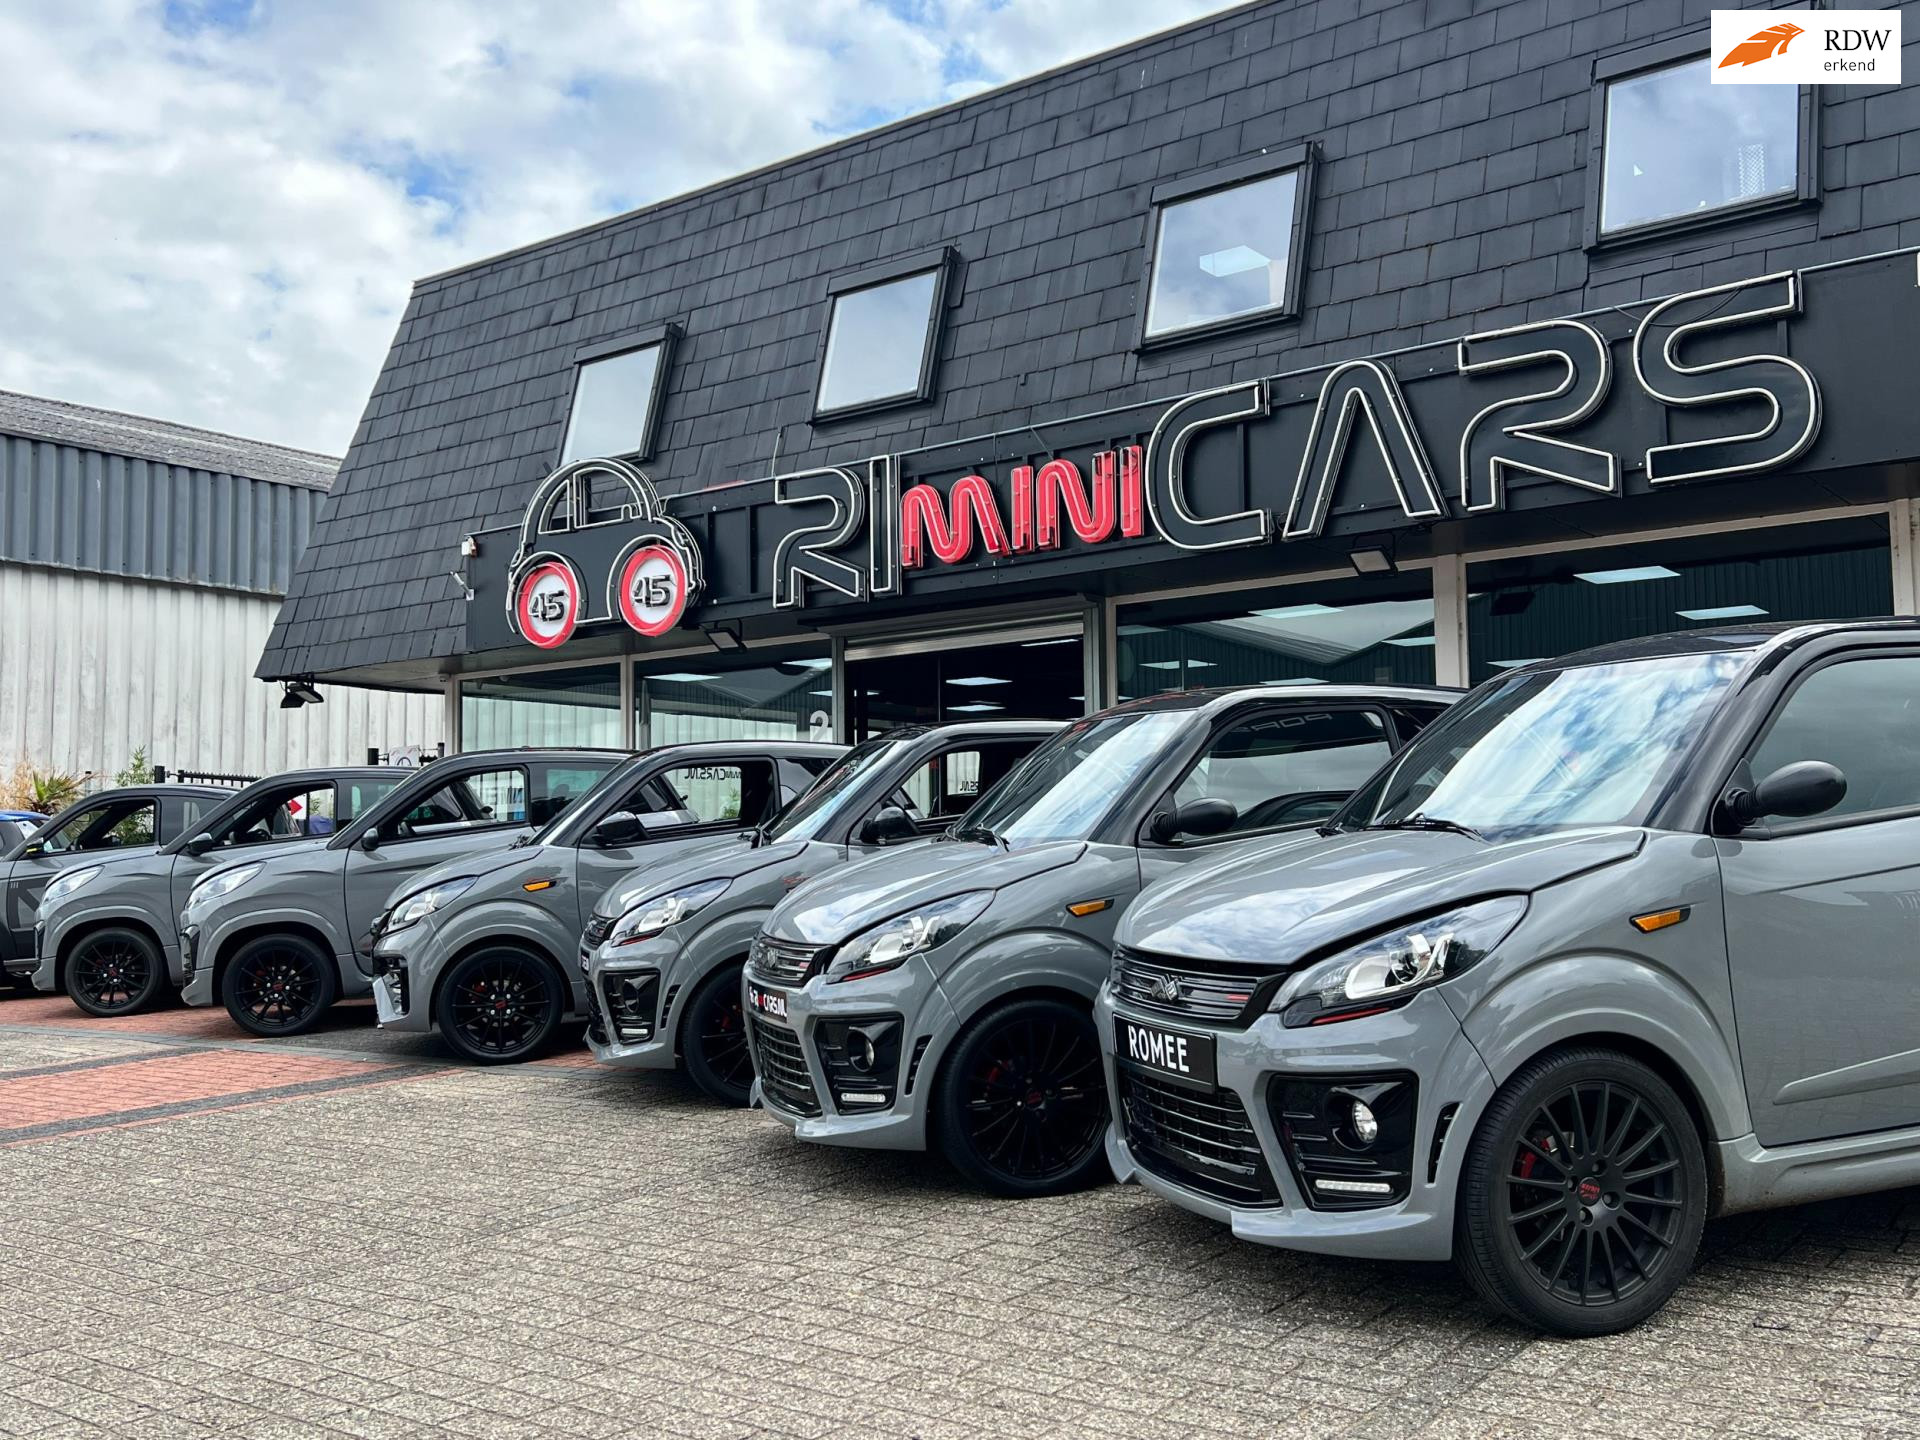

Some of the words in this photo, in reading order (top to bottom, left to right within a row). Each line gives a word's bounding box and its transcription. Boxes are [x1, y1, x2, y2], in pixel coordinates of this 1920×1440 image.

[527, 589, 566, 622] 45
[632, 574, 672, 608] 45
[1127, 1025, 1189, 1073] ROMEE
